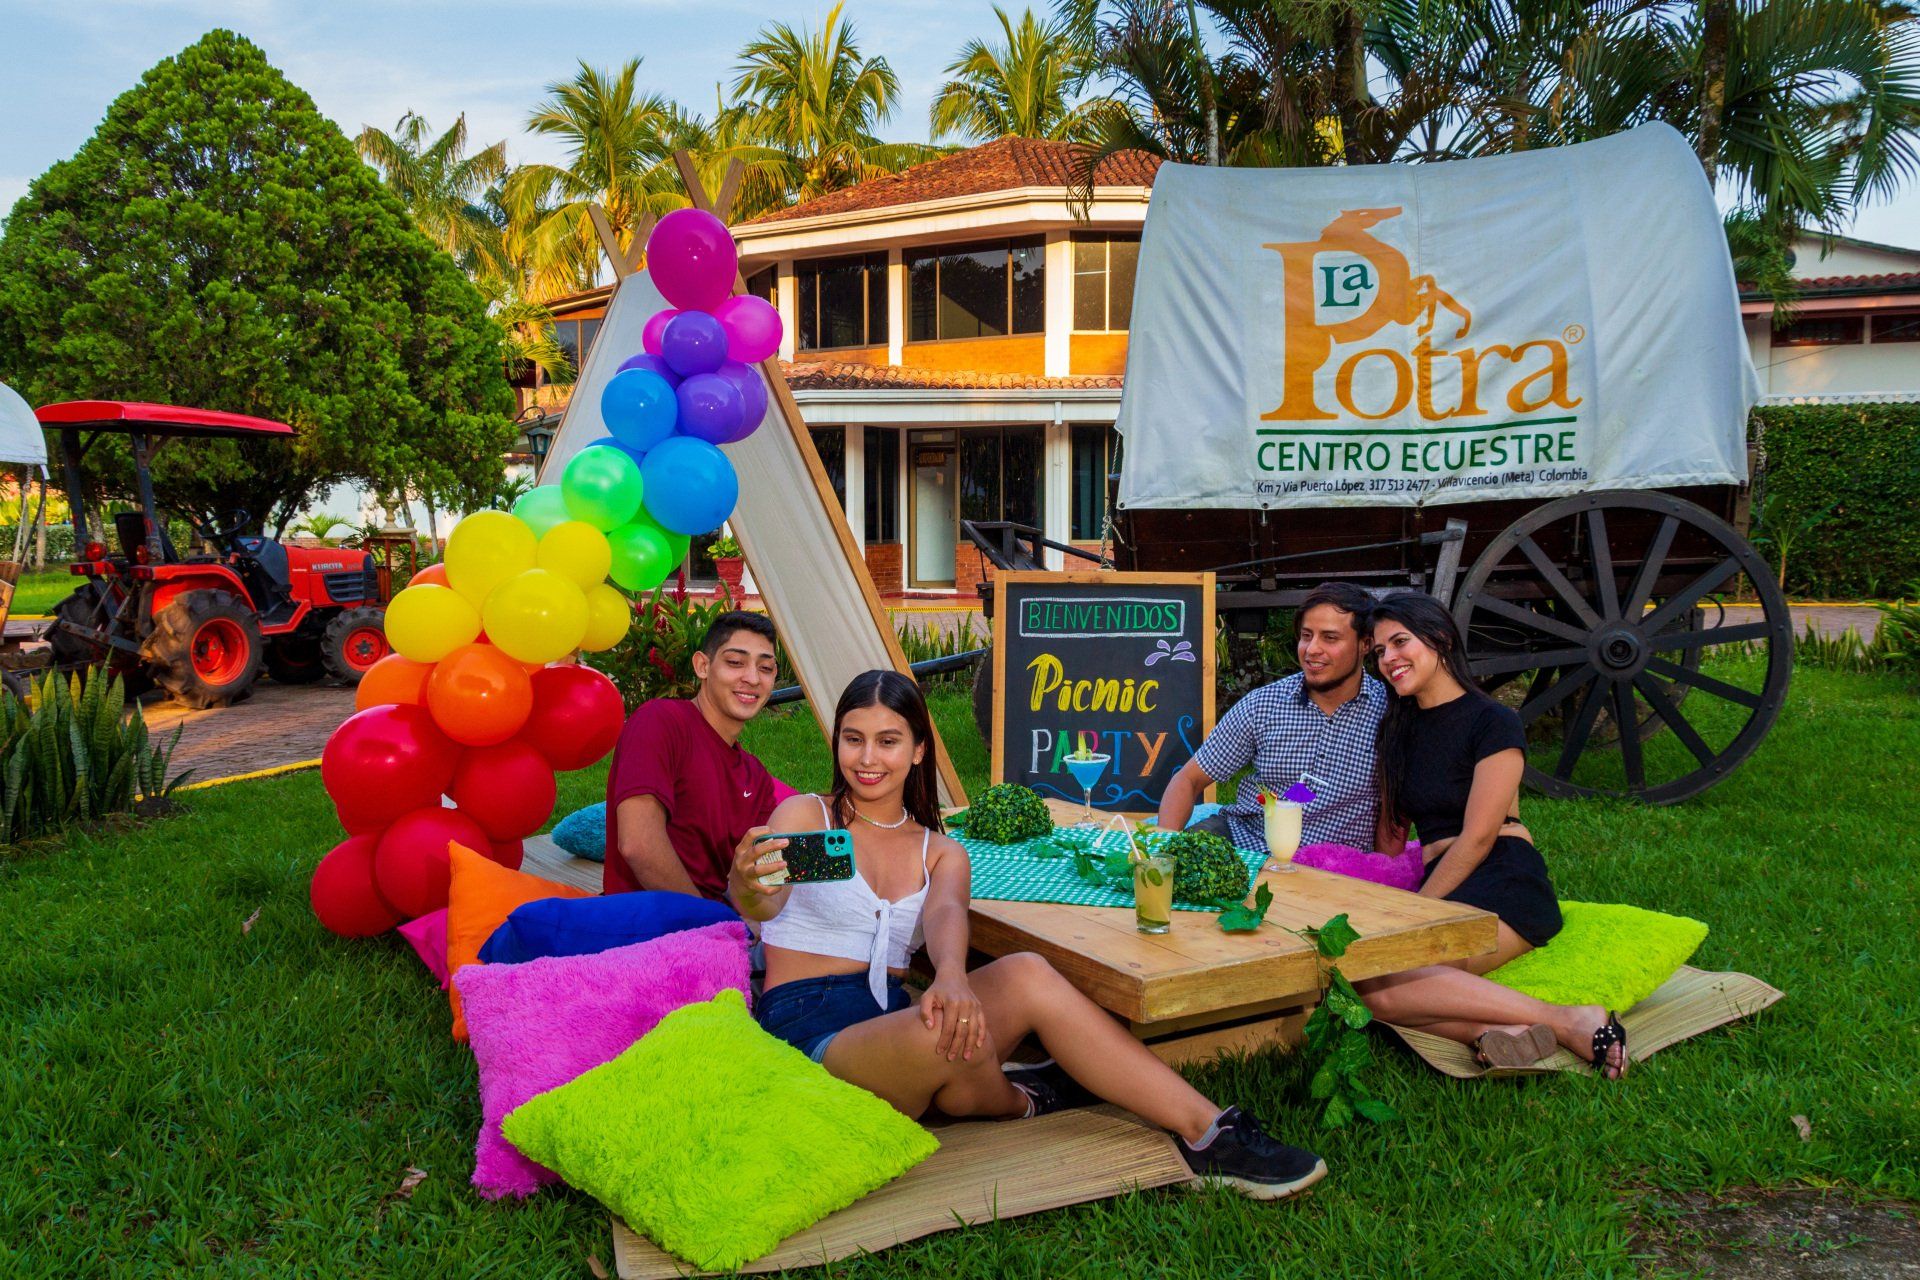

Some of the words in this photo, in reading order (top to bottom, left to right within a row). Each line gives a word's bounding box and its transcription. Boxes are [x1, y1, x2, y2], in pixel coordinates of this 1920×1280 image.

[1319, 263, 1374, 307] La
[1260, 206, 1583, 421] Potra
[1257, 442, 1391, 471] CENTRO
[1401, 431, 1576, 472] ECUESTRE
[1257, 482, 1273, 493] Km
[1275, 484, 1281, 496] 7
[1300, 479, 1333, 491] Puerto
[1335, 479, 1365, 494] López
[1369, 479, 1386, 490] 317
[1388, 479, 1404, 490] 513
[1406, 479, 1429, 492] 2477
[1501, 470, 1535, 485] (Meta)
[1539, 467, 1588, 481] Colombia
[311, 562, 344, 571] KUBOTA
[1028, 602, 1178, 630] BIENVENIDOS
[1026, 653, 1159, 712] Picnic
